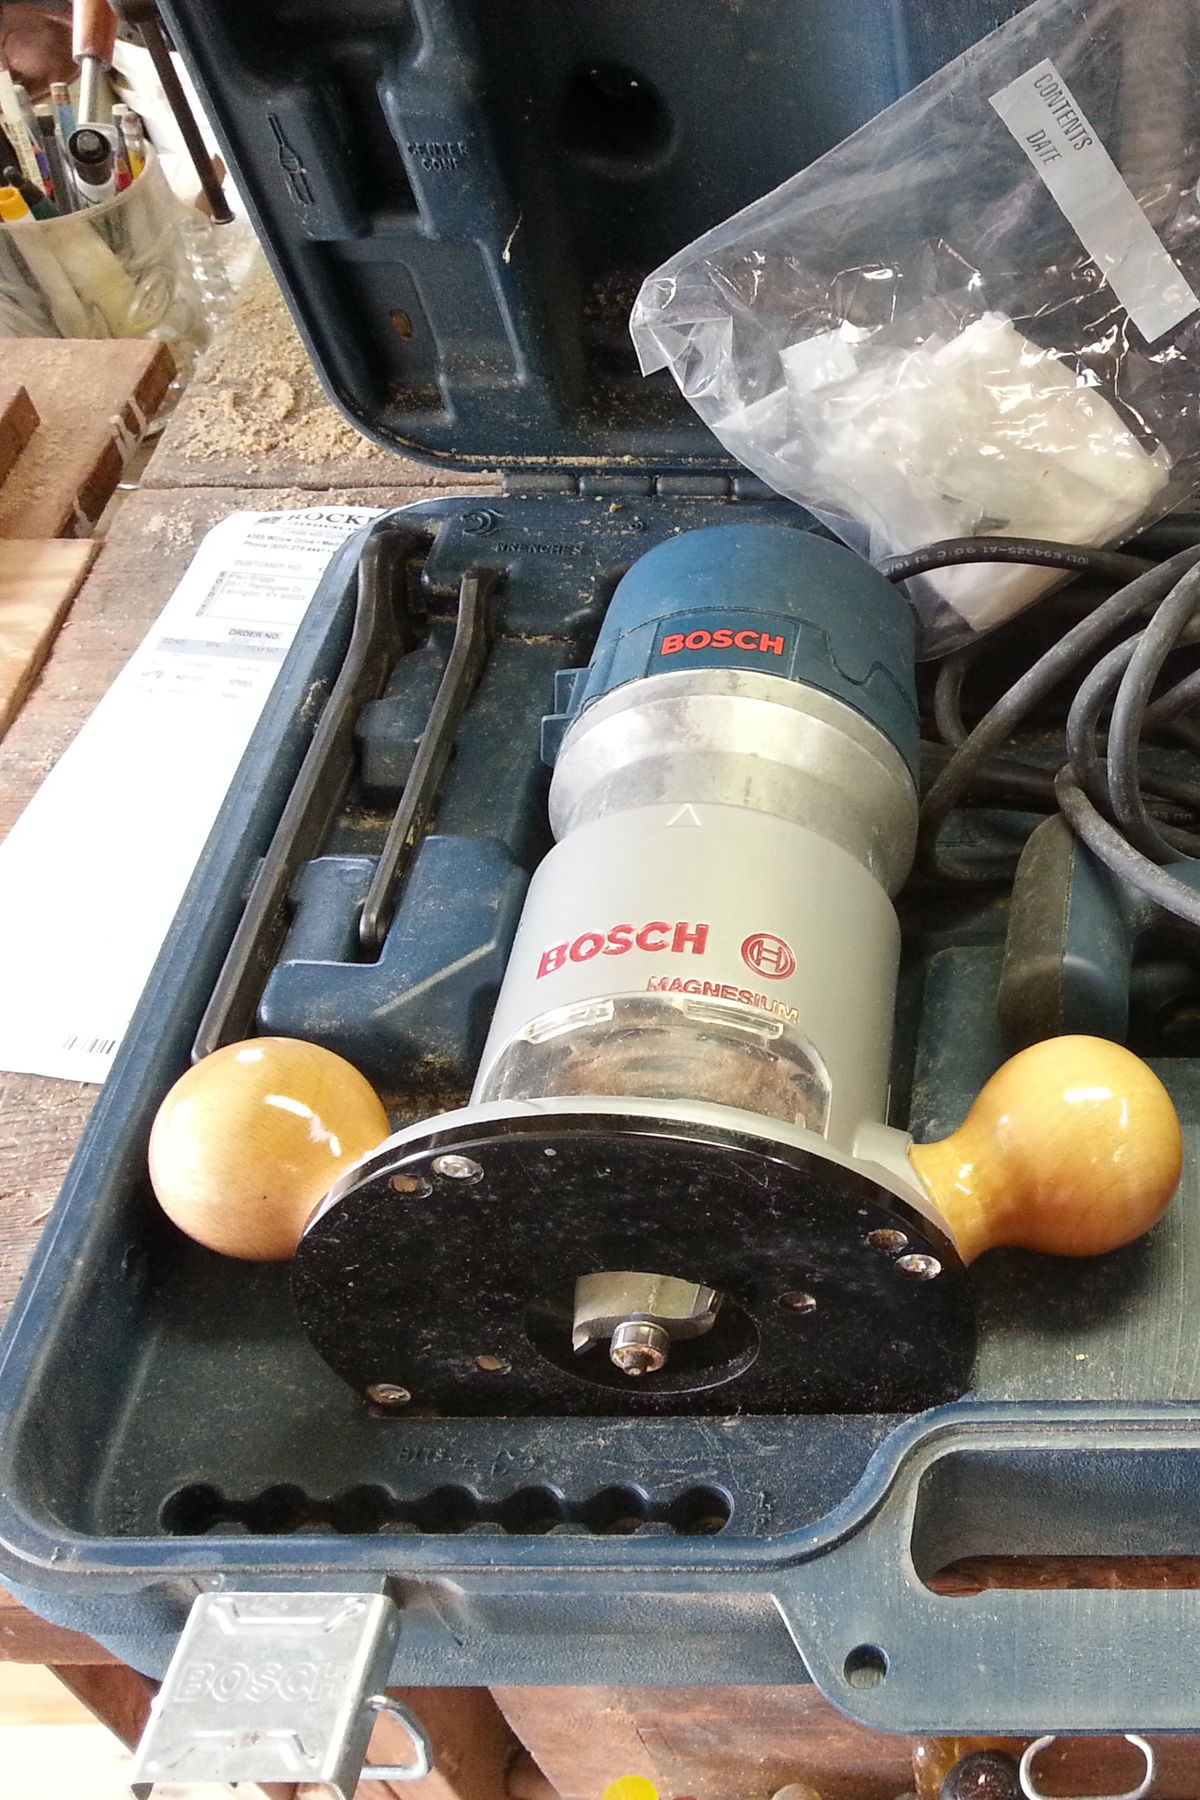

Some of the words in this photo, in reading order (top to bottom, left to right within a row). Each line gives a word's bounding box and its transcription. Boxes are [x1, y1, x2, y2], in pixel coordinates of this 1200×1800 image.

[1034, 73, 1093, 151] CONTENTS
[1026, 129, 1062, 165] DATE
[661, 628, 785, 656] BOSCH
[536, 920, 710, 980] BOSCH
[646, 975, 800, 1024] MAGNESIUM
[174, 1662, 348, 1702] BOSCH
